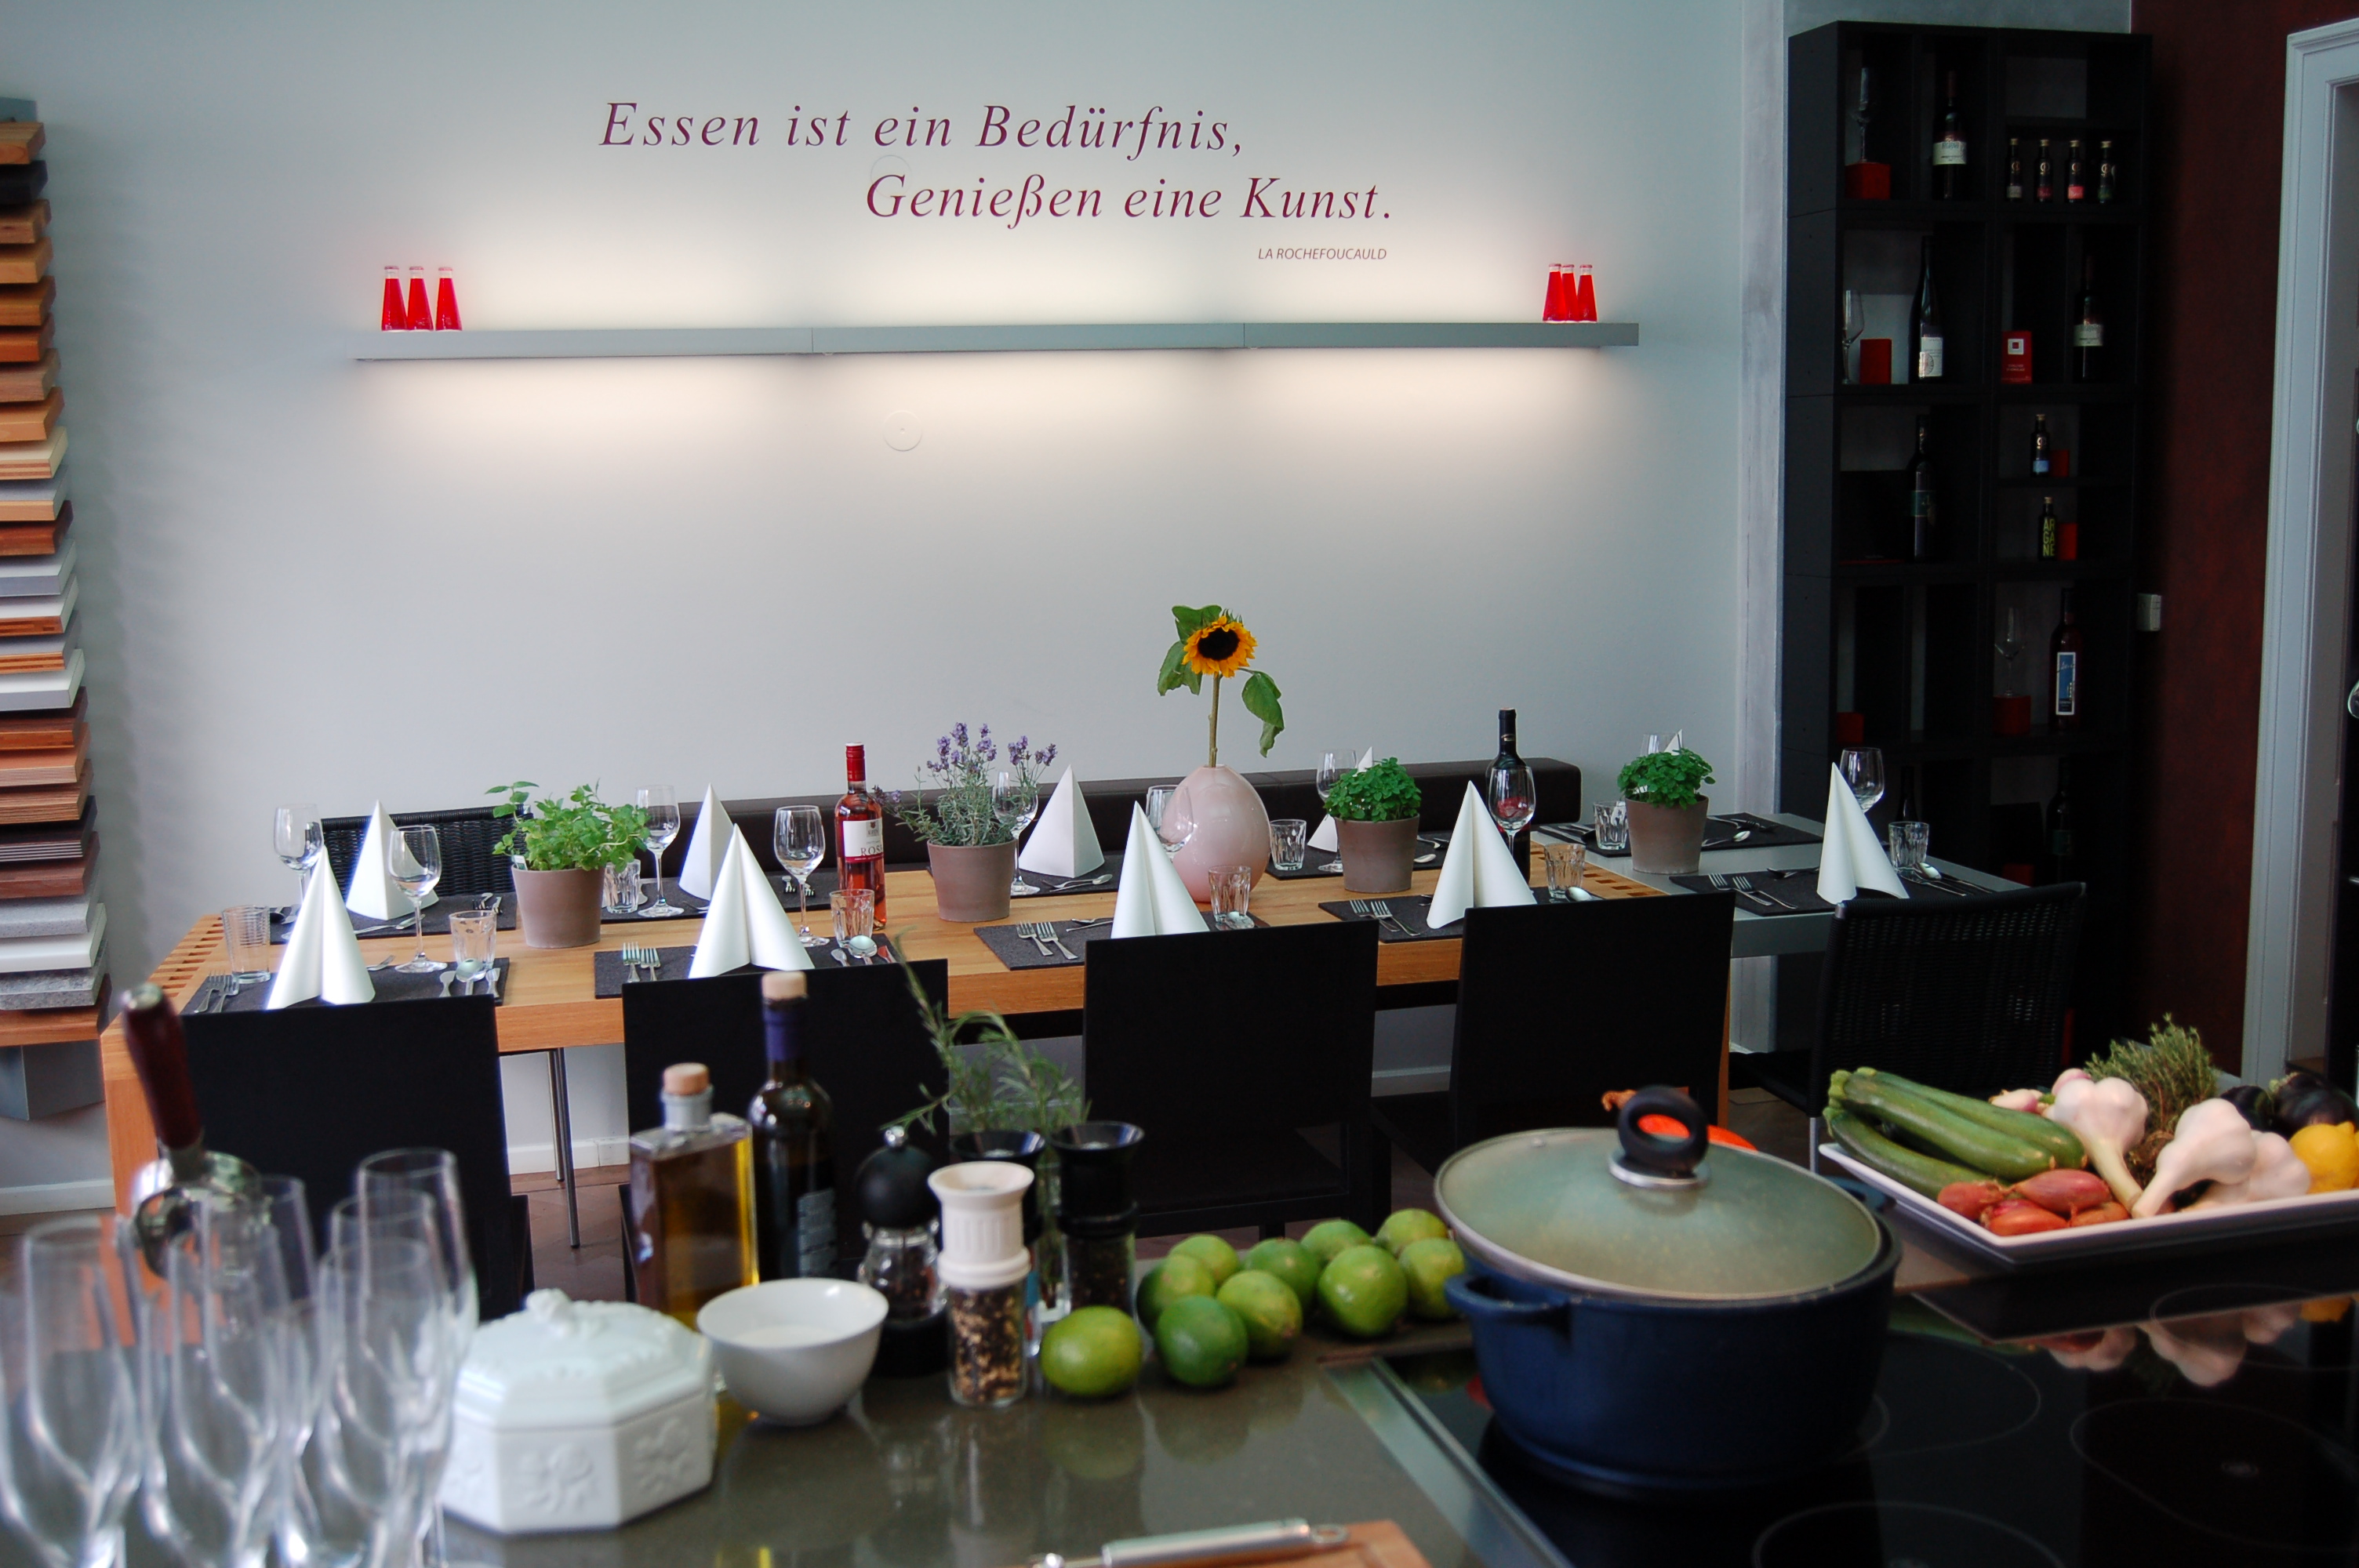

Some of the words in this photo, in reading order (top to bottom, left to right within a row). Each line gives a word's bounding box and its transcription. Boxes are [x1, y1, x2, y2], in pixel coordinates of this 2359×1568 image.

[598, 102, 760, 147] Essen
[787, 105, 851, 147] ist
[874, 106, 951, 147] ein
[975, 104, 1241, 162] Bedürfnis,
[867, 173, 1102, 230] Genießen
[1124, 178, 1222, 218] eine
[1239, 177, 1390, 220] Kunst.
[1258, 248, 1274, 260] LA
[1276, 248, 1387, 260] ROCHEFOUCAULD
